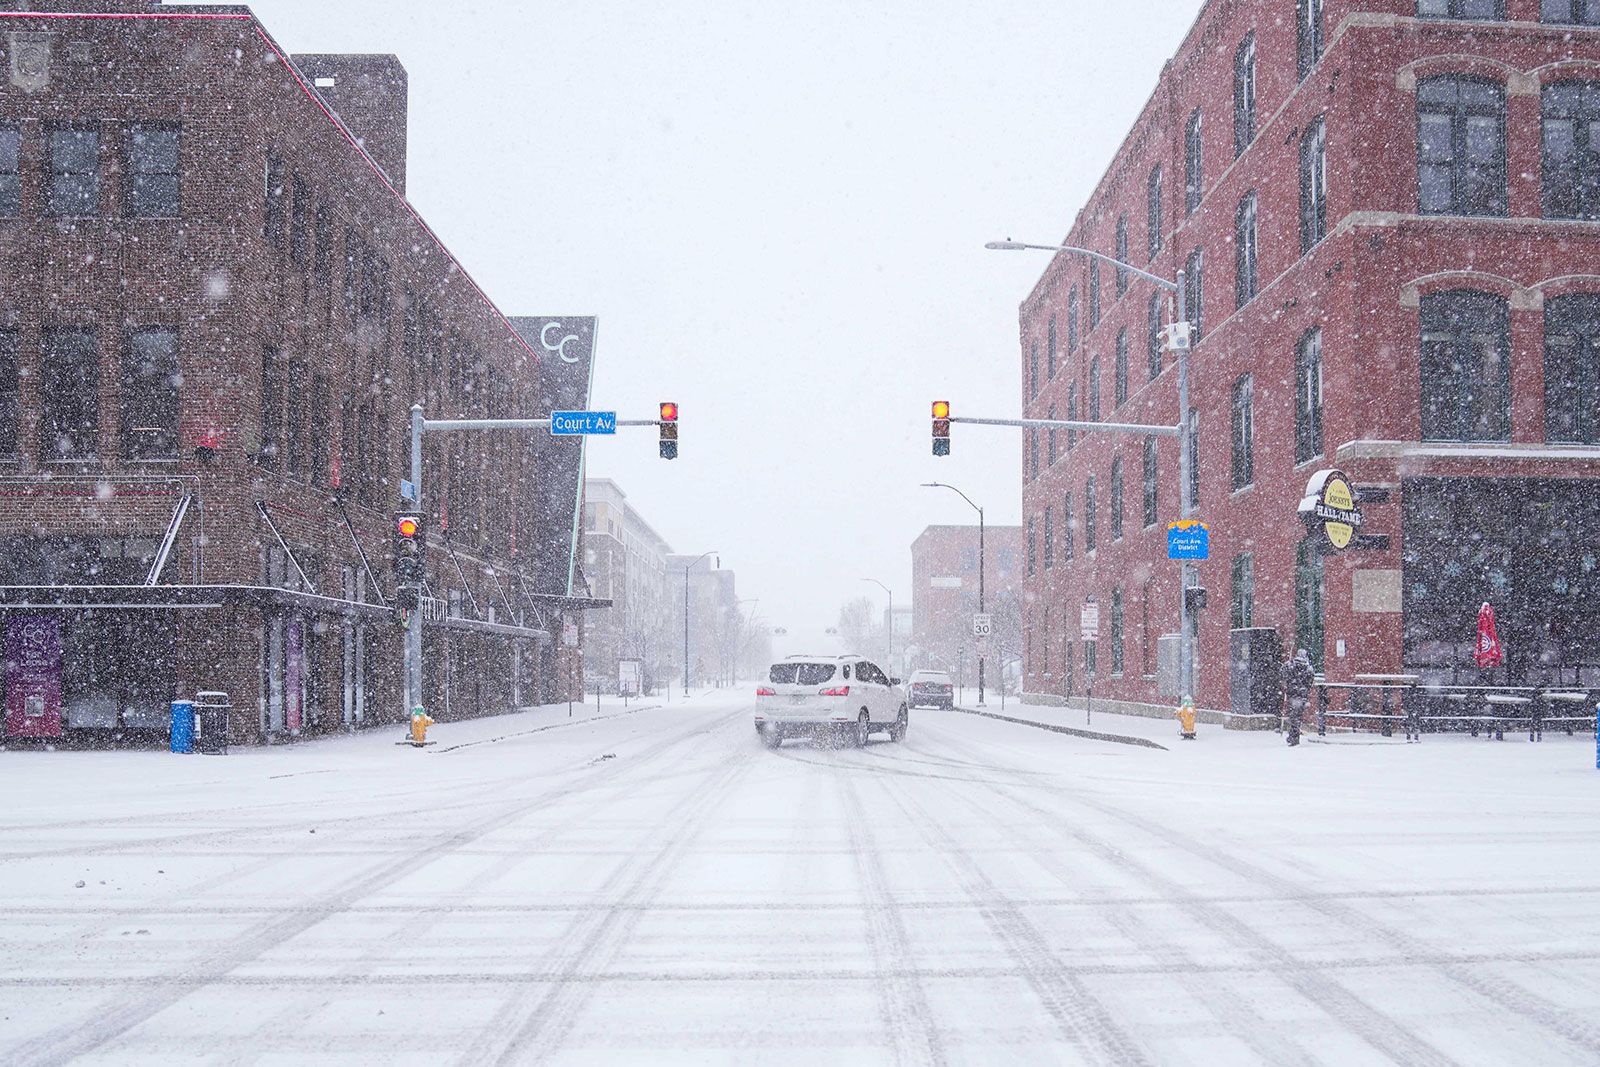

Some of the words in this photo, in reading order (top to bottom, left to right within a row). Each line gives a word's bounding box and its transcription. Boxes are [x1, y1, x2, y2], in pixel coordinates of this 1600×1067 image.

[555, 416, 592, 430] Court
[1317, 505, 1337, 519] HALL
[1172, 537, 1189, 545] Court
[975, 625, 990, 634] 30
